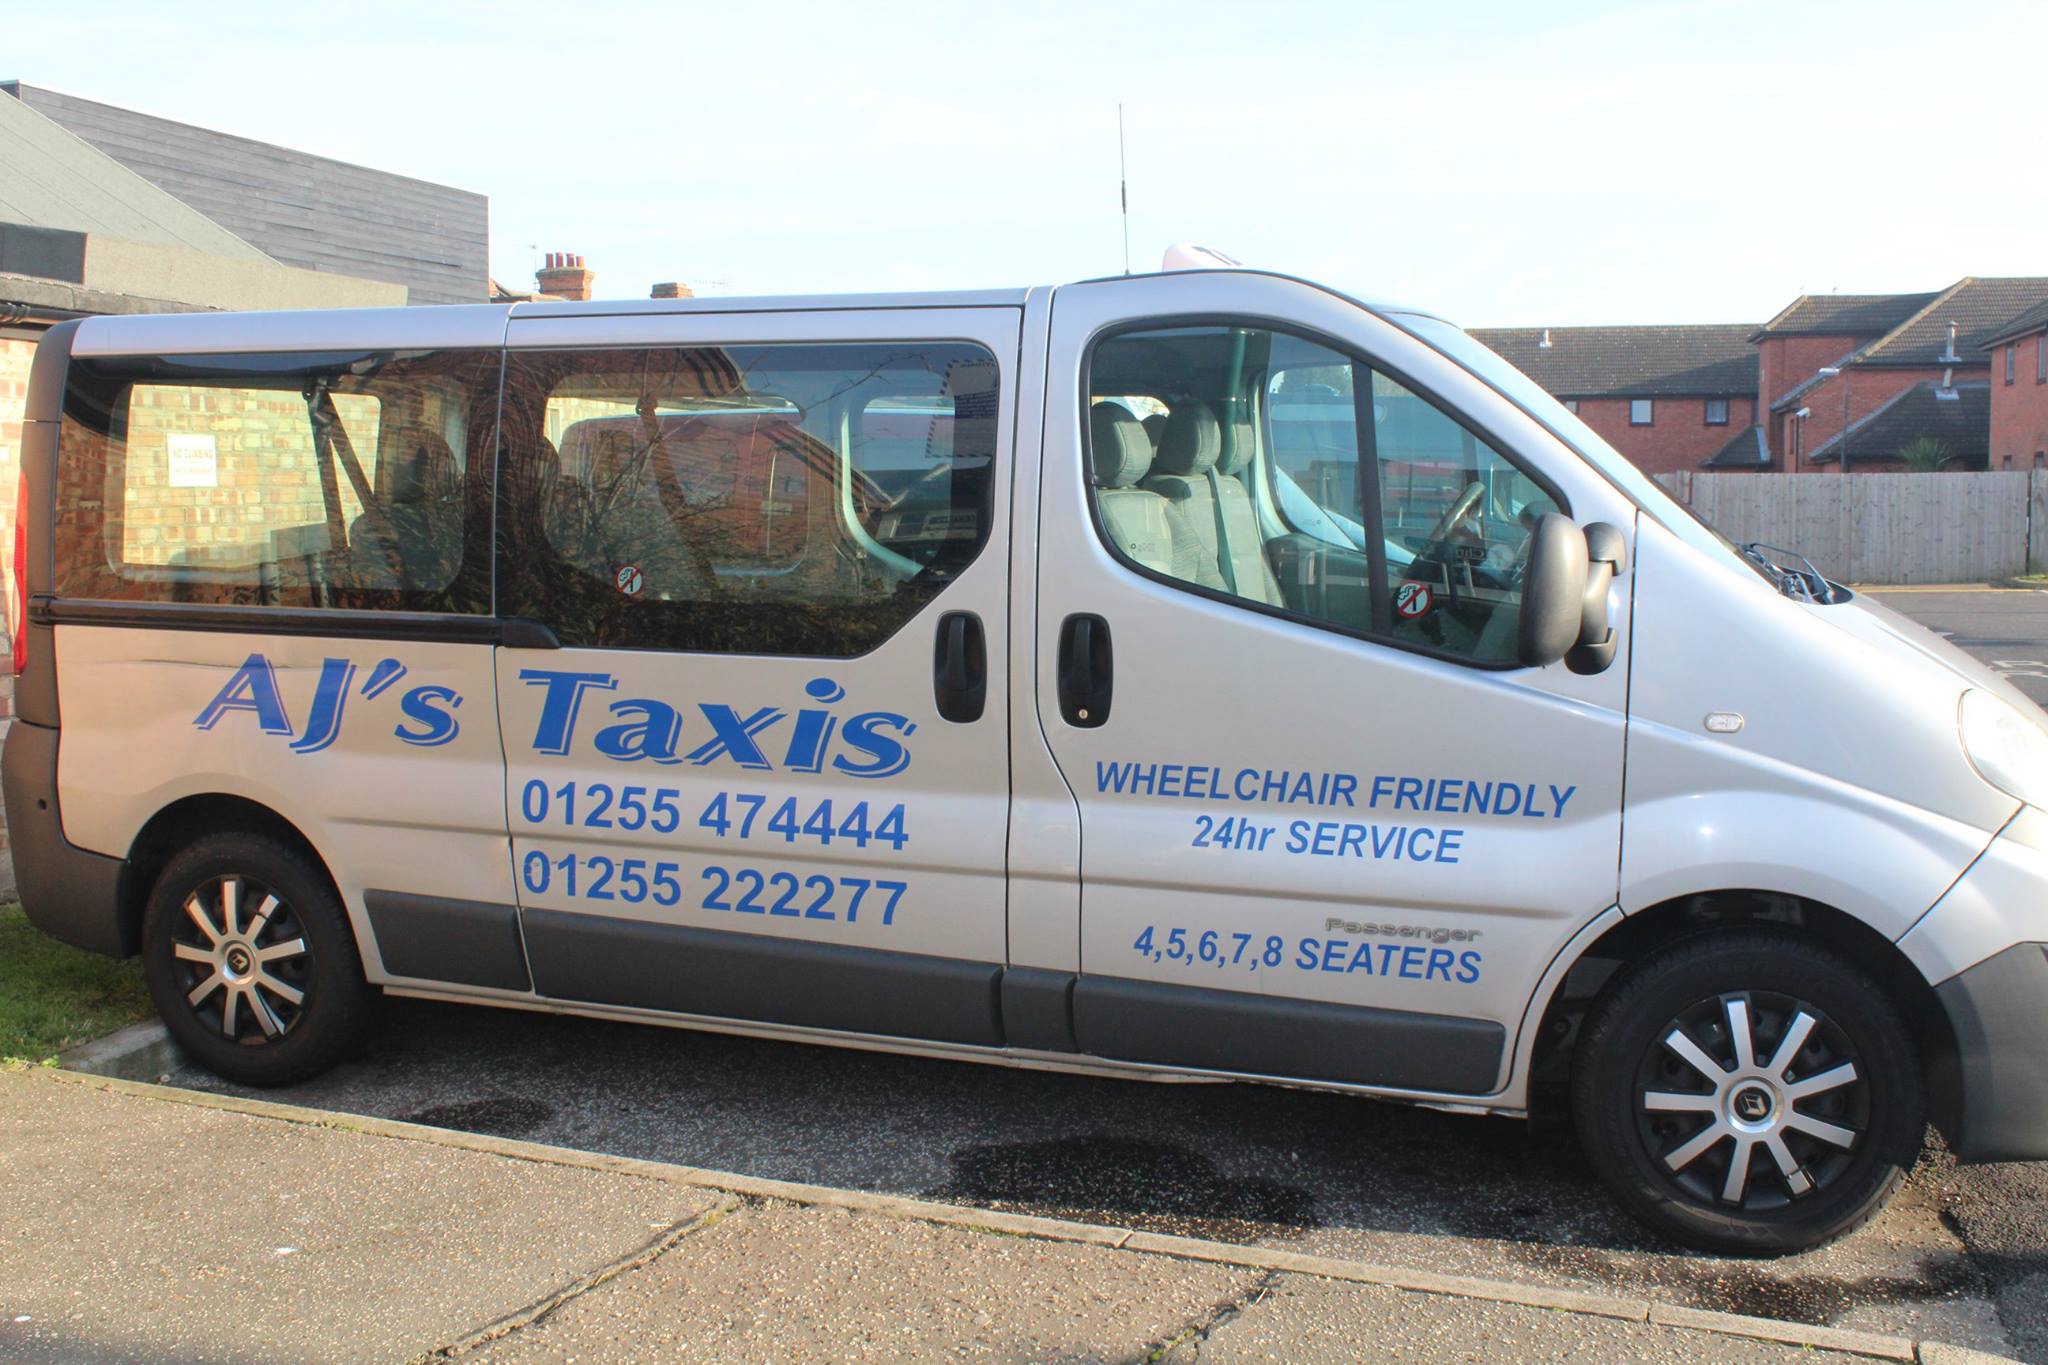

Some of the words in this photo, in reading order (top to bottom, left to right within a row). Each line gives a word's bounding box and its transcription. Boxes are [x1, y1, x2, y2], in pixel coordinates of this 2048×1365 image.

[192, 653, 464, 754] AJ's
[518, 669, 918, 779] Taxis
[521, 779, 681, 833] 01255
[699, 791, 909, 850] 474444
[1096, 761, 1358, 808] WHEELCHAIR
[1369, 775, 1577, 819] FRIENDLY
[1191, 814, 1276, 853] 24hr
[1285, 819, 1465, 864] SERVICE
[523, 850, 682, 907] 01255
[701, 866, 908, 926] 222277
[1134, 926, 1285, 971] 4,5,6,7,8
[1295, 937, 1483, 985] SEATERS
[1325, 917, 1483, 944] Passenger
